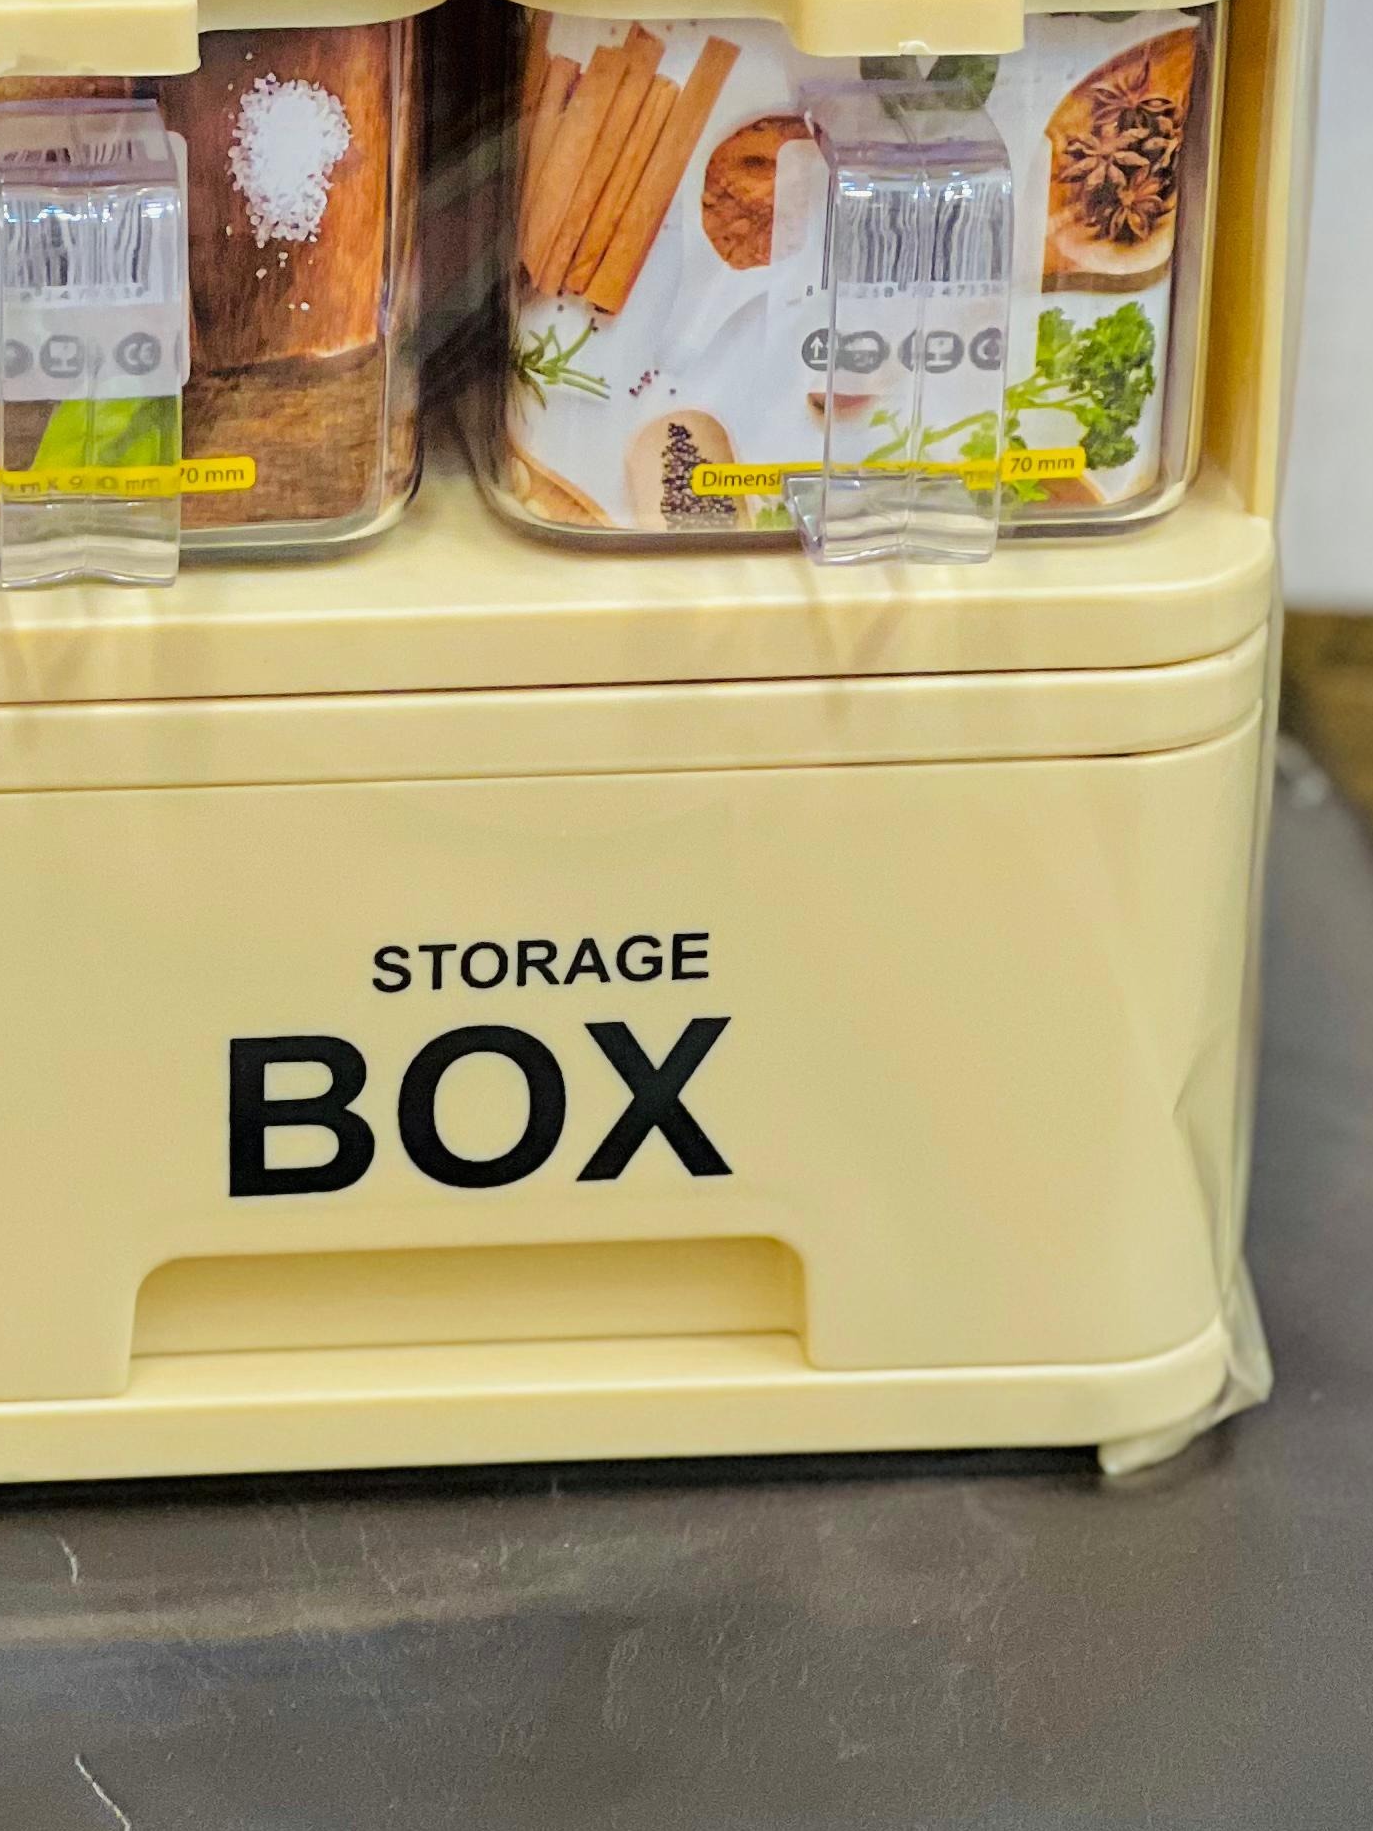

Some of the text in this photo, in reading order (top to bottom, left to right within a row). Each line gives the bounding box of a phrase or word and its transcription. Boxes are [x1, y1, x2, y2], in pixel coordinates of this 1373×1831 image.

[205, 467, 245, 483] mm
[702, 456, 1076, 488] Dimensi 70 mm
[372, 932, 710, 993] STORAGE
[229, 1016, 734, 1197] BOX
